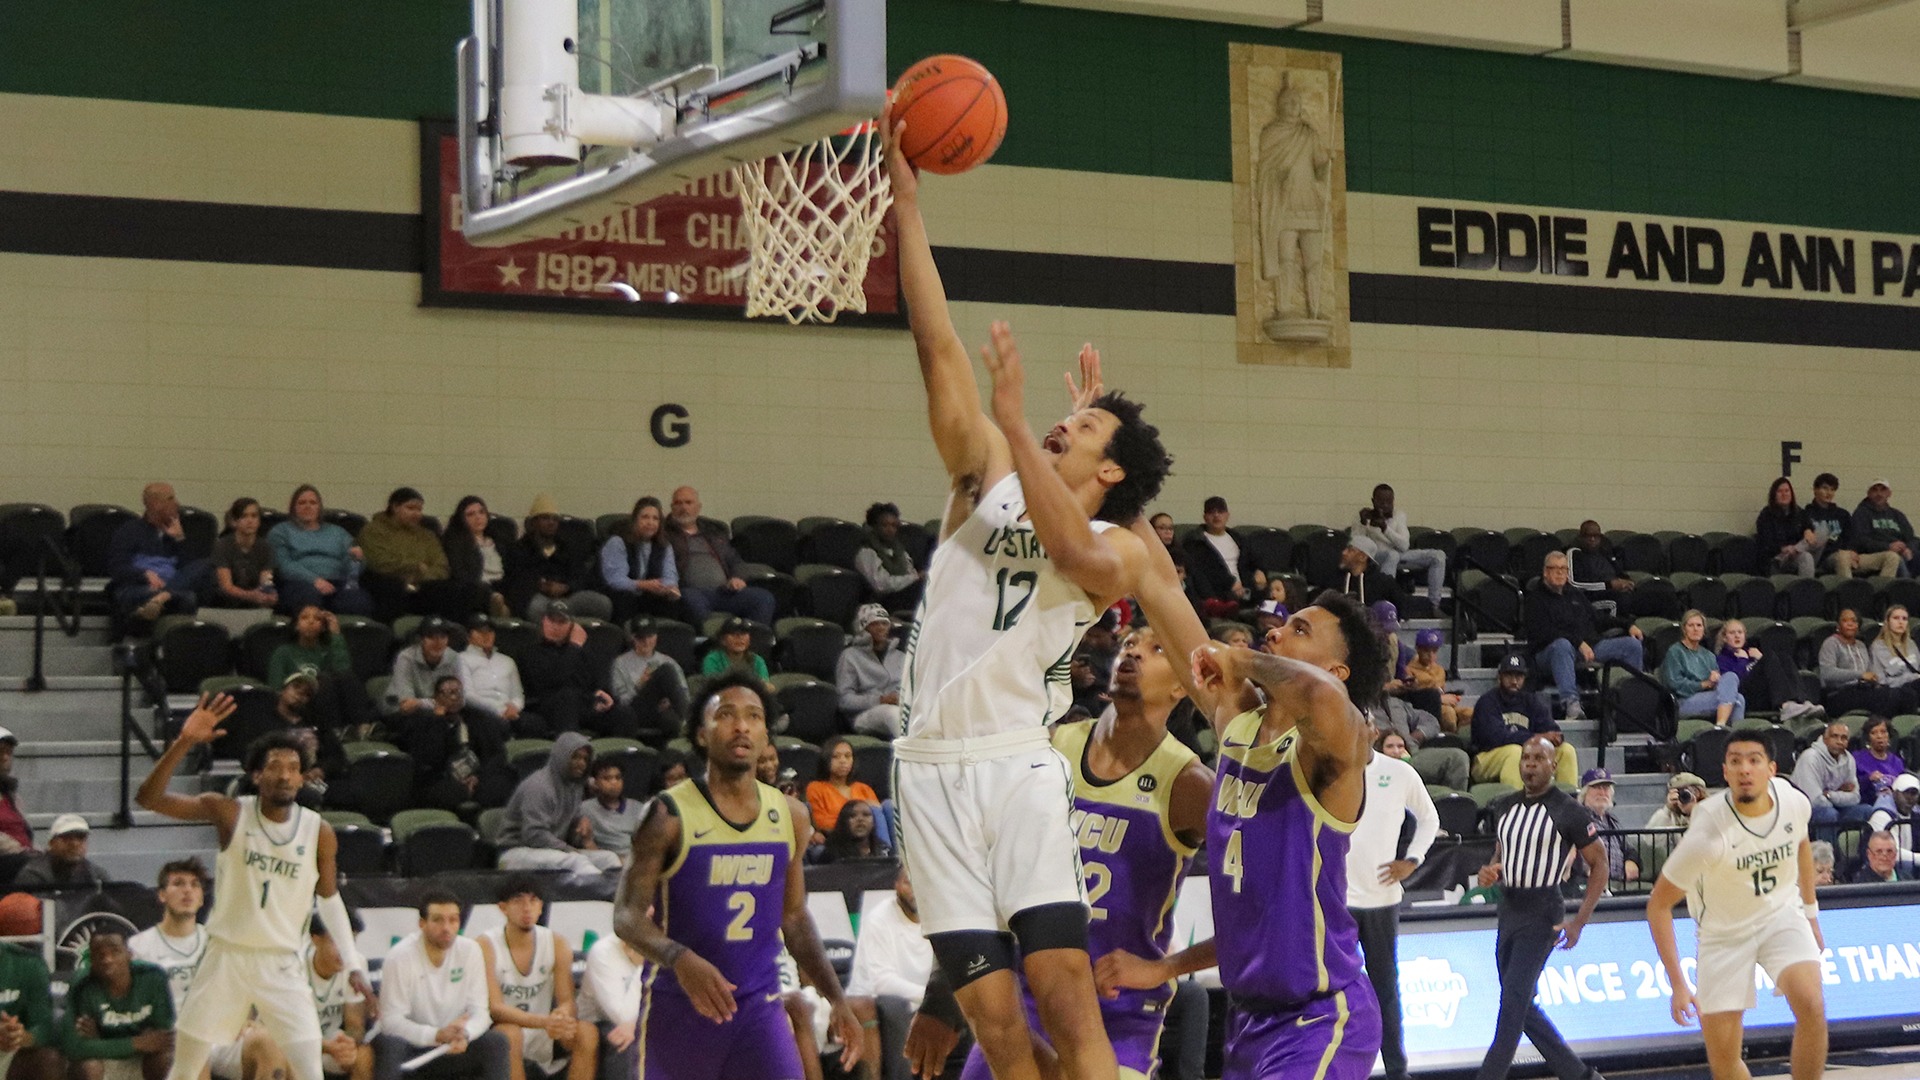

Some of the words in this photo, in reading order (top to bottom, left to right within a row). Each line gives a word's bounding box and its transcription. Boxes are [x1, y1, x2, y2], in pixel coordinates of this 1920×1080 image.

[1417, 206, 1589, 277] EDDIE
[1605, 221, 1725, 285] AND
[1742, 231, 1856, 294] ANN
[536, 252, 617, 293] 1982
[627, 261, 698, 294] MEN'S
[650, 403, 691, 448] G
[1780, 441, 1802, 478] F
[992, 567, 1038, 631] 12
[245, 849, 301, 880] UPSTATE
[709, 853, 775, 886] WCU
[1223, 829, 1244, 894] 4
[1736, 841, 1794, 871] UPSTATE
[260, 879, 271, 909] 1
[1752, 865, 1778, 896] 15
[726, 890, 757, 941] 2
[1533, 962, 1627, 1006] INCE
